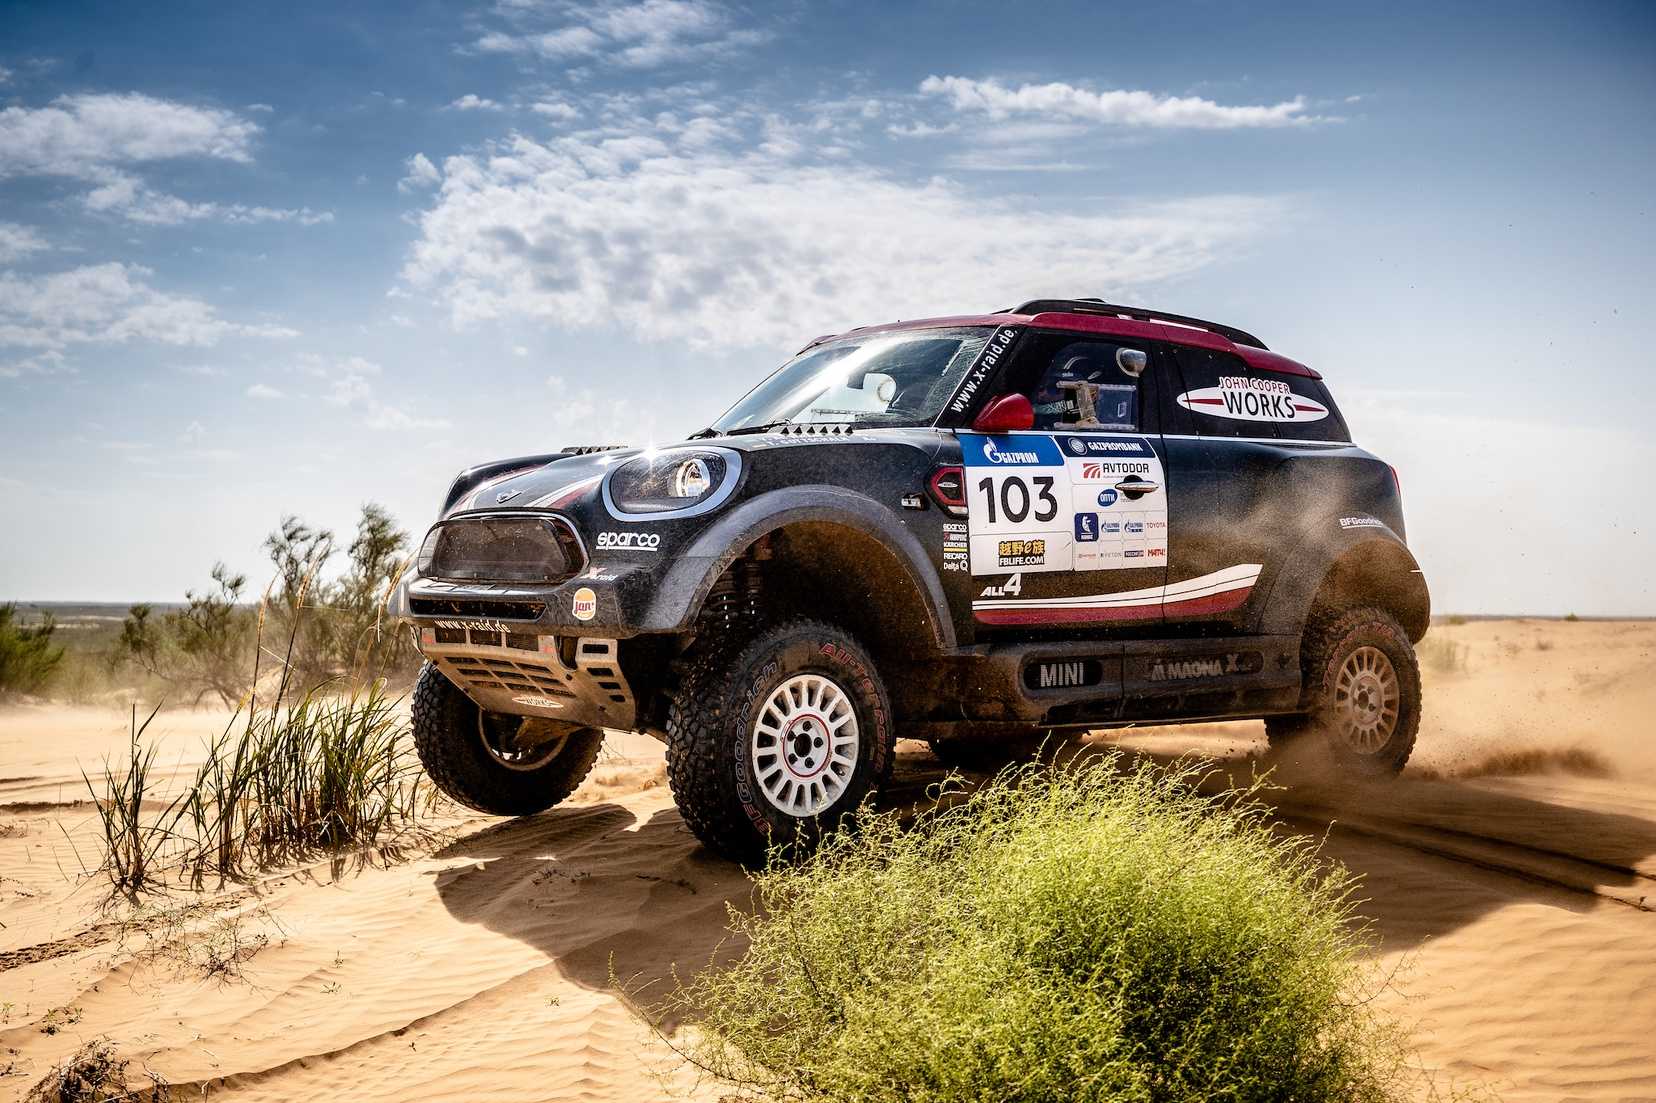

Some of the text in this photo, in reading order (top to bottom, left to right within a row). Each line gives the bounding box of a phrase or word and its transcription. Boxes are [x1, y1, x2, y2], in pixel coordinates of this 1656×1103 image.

[951, 329, 1014, 413] www.x-raid.de
[1219, 377, 1290, 394] JOHN COOPER
[1223, 391, 1296, 419] WORKS
[1087, 441, 1144, 452] GAZPROMBANK
[1000, 452, 1040, 464] GAZPROM
[1103, 462, 1150, 474] AVTODOR
[978, 476, 1058, 523] 103
[596, 531, 661, 551] sparco
[943, 552, 968, 560] RECARO
[999, 555, 1044, 566] FBLIFE.COM
[433, 618, 511, 634] www.x-raid.de
[1039, 662, 1085, 688] MINI
